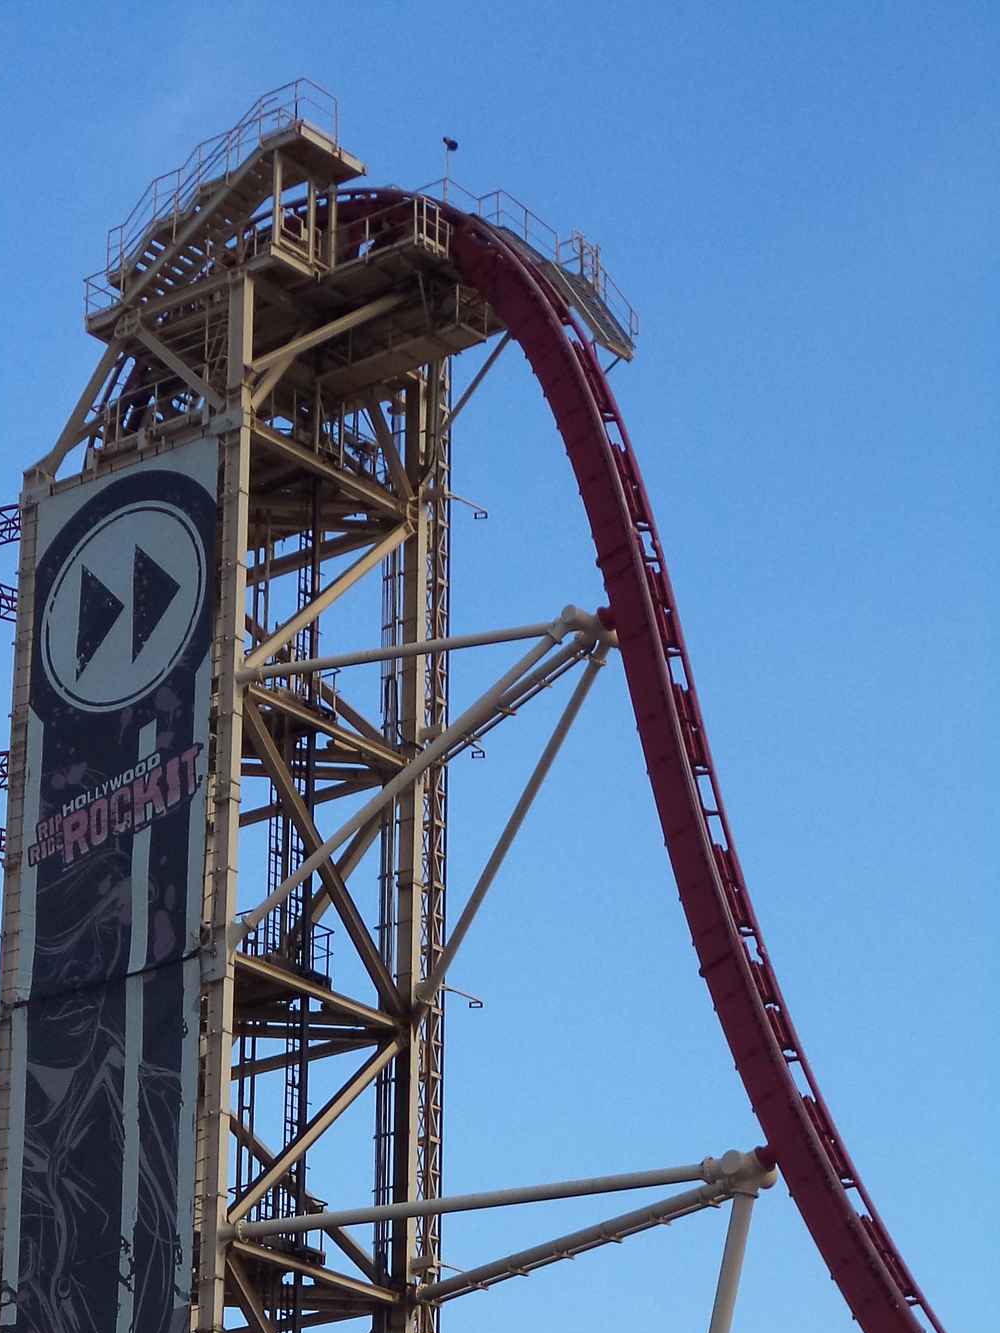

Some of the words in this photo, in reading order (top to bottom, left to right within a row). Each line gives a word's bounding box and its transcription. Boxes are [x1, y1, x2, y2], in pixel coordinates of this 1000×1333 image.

[61, 752, 161, 817] HOLLYWOOD
[61, 743, 201, 865] ROCKIT
[37, 813, 64, 842] RIP
